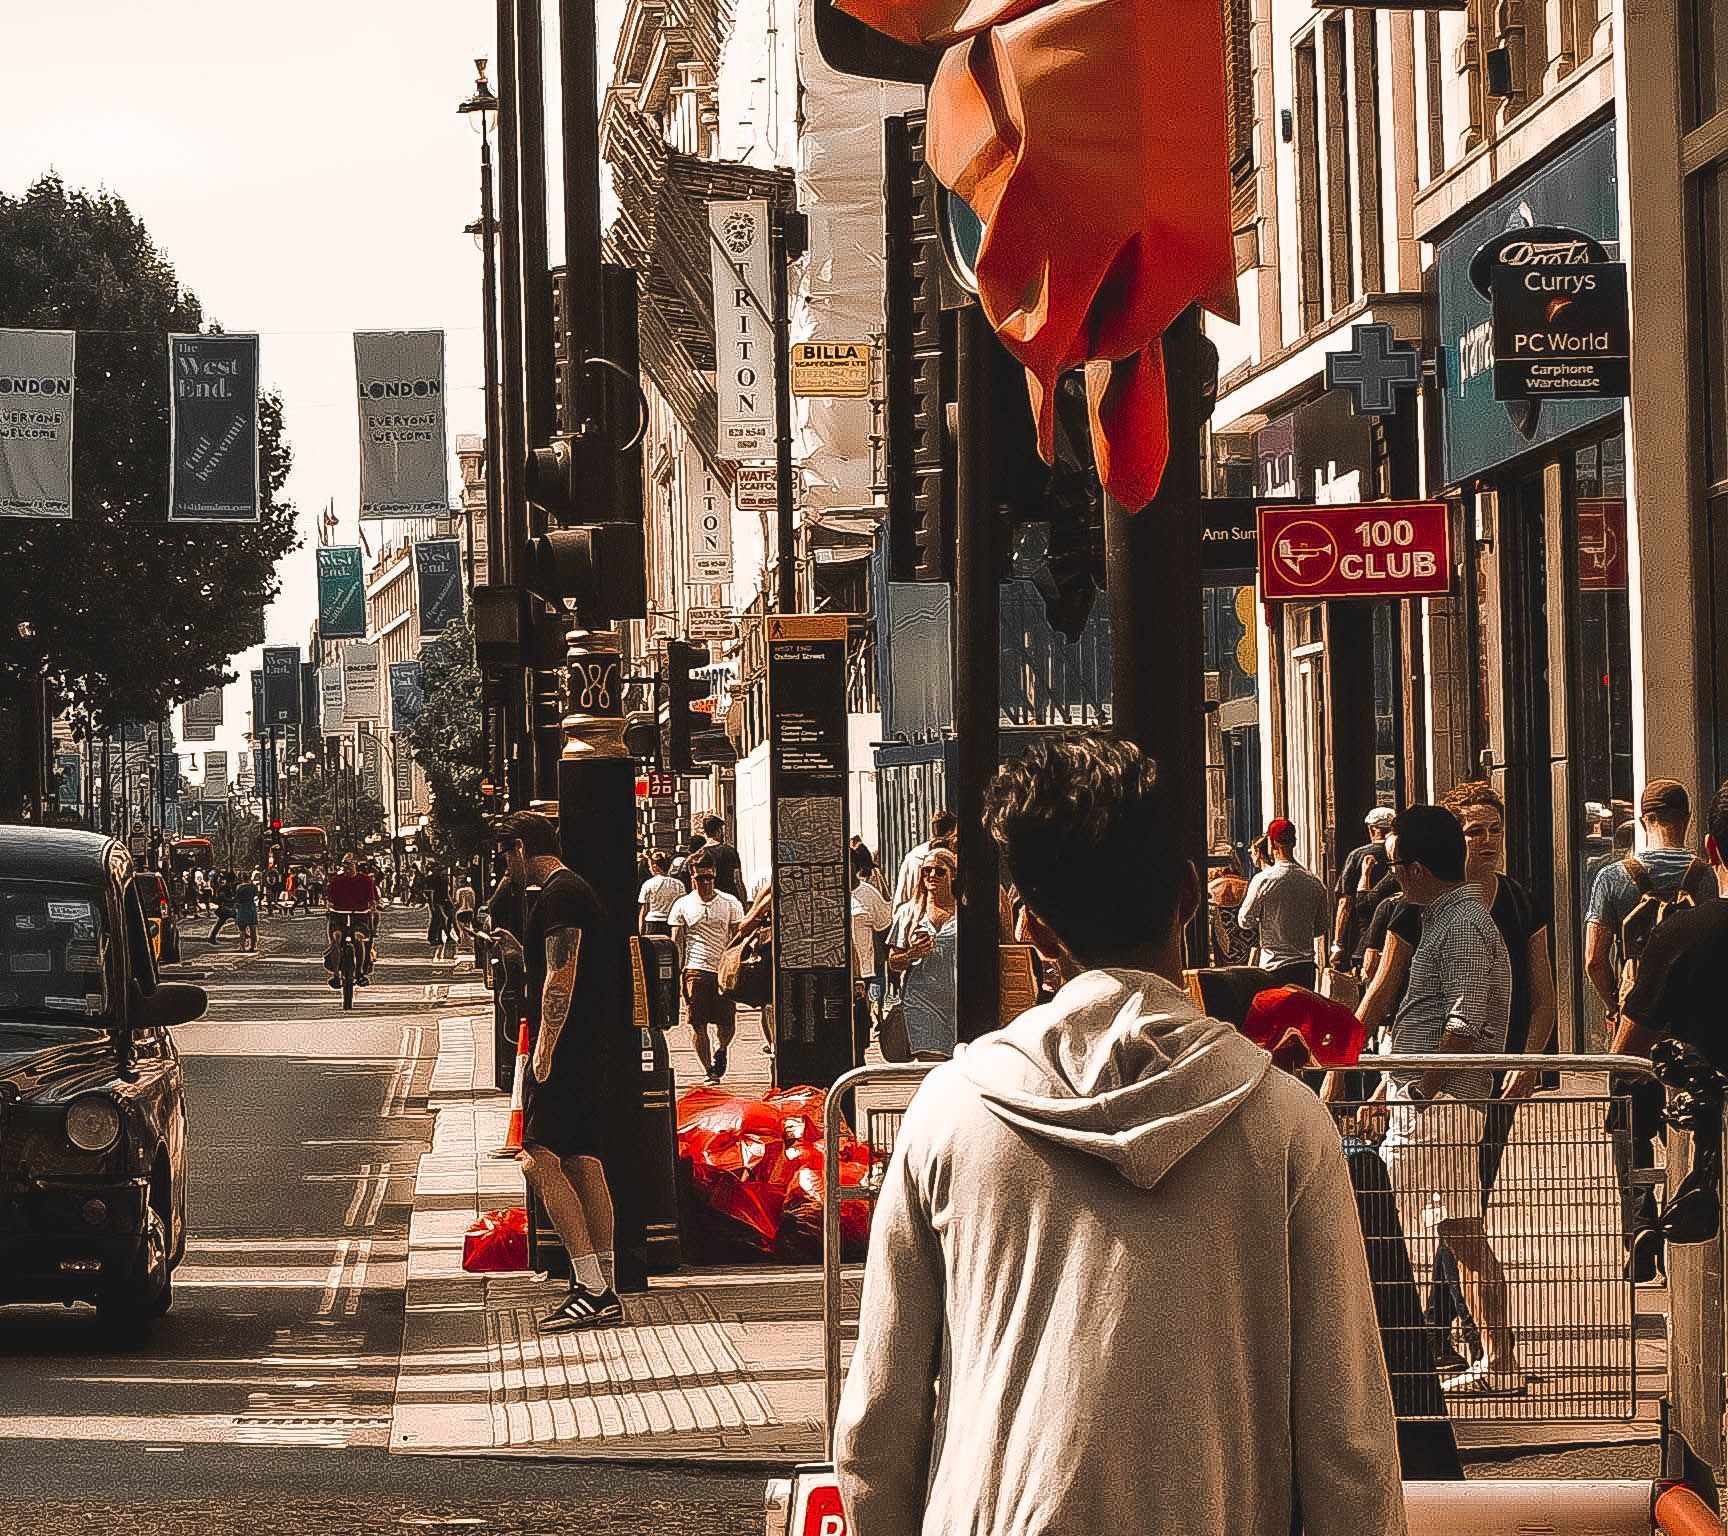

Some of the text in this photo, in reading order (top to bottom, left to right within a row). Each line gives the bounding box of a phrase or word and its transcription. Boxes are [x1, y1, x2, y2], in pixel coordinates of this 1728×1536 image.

[1524, 272, 1597, 294] Currys
[1514, 332, 1609, 353] PC World
[803, 345, 859, 360] BILLA
[178, 357, 240, 376] West
[1530, 364, 1594, 375] Carphone
[178, 378, 232, 398] End.
[359, 379, 440, 399] LONDON
[1526, 377, 1601, 389] Warehouse
[367, 415, 437, 428] EVERYONE
[372, 431, 433, 442] WELCOME
[1202, 528, 1228, 541] Ann
[1354, 519, 1414, 548] 100
[1339, 551, 1437, 580] CLUB
